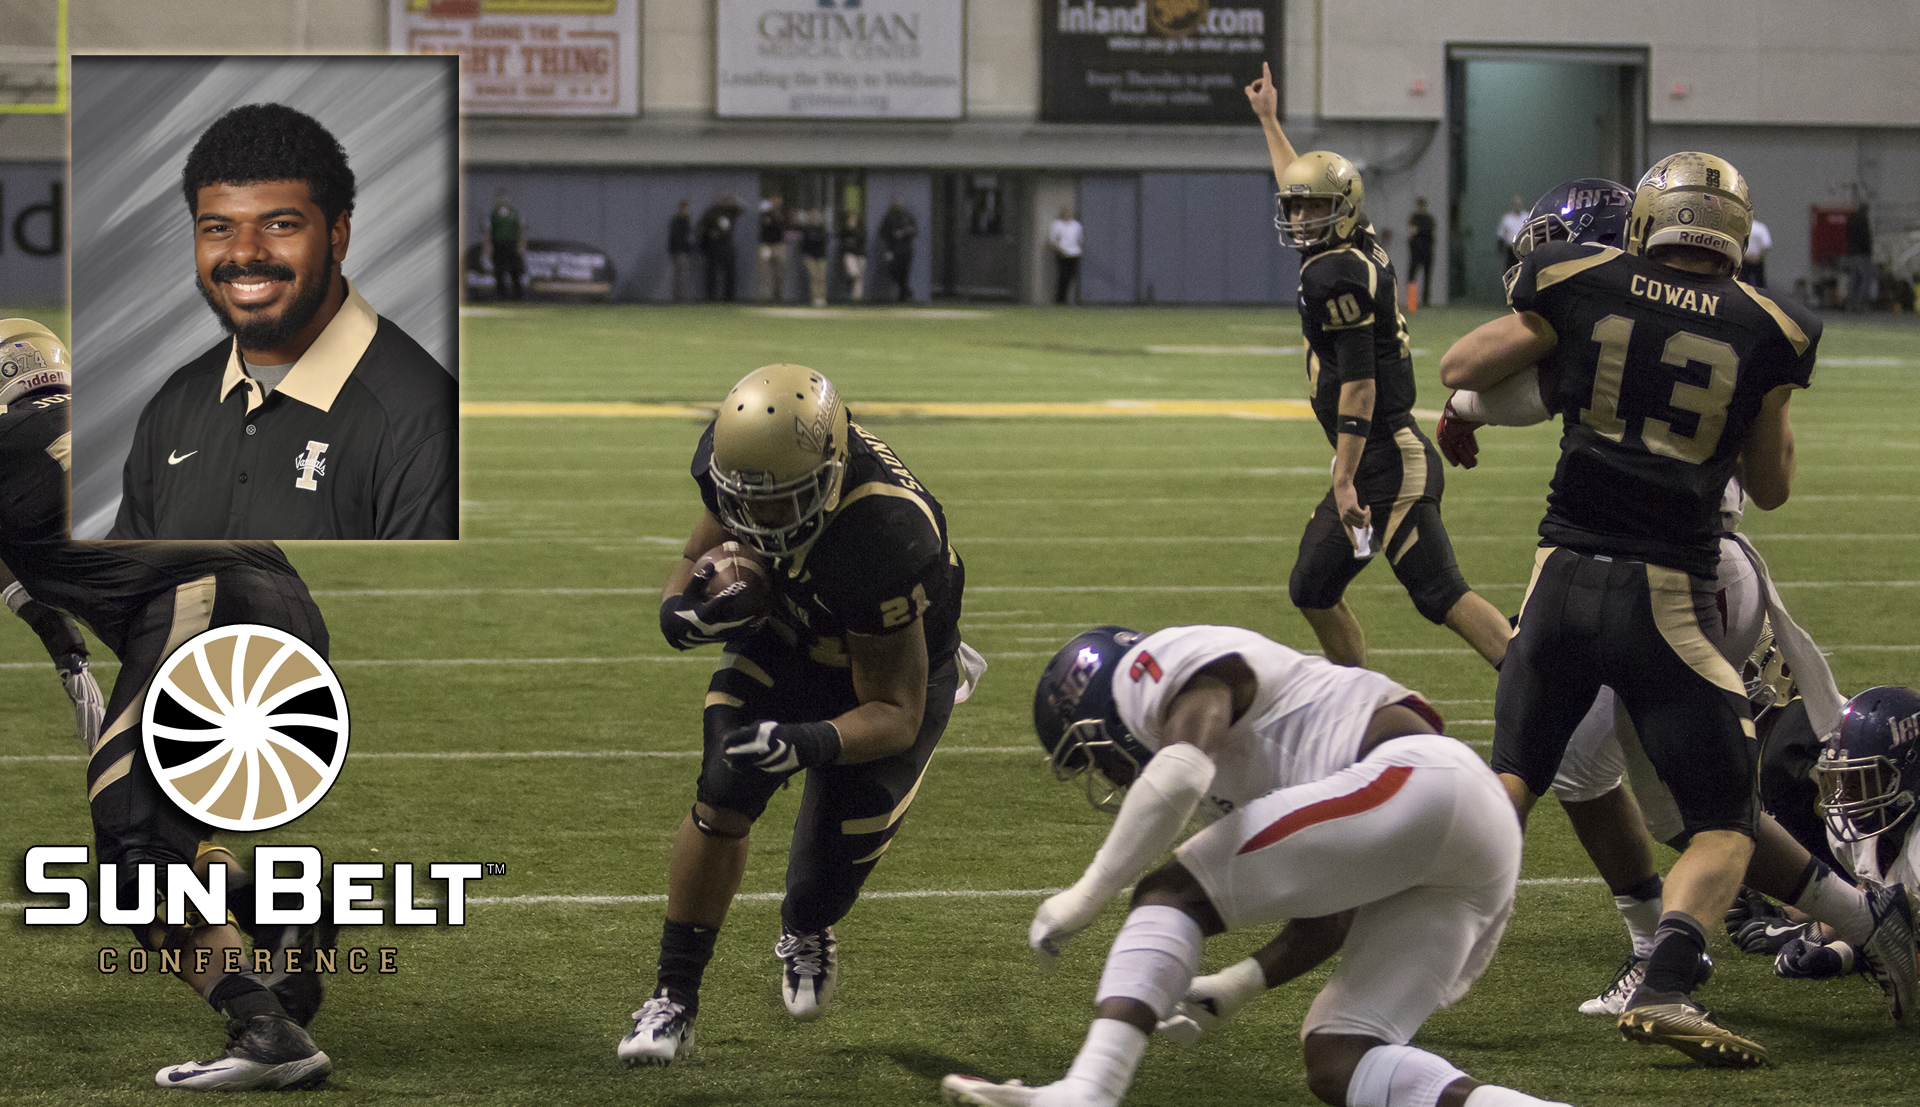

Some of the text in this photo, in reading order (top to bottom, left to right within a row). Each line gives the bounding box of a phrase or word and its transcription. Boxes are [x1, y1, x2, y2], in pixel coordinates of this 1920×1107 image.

[757, 10, 920, 40] GRITMAN
[1058, 0, 1147, 33] inland
[1199, 8, 1265, 34] .com
[520, 46, 609, 75] THING
[1680, 231, 1730, 250] Riddell
[1326, 293, 1361, 326] 10
[1631, 274, 1720, 316] COWAN
[15, 350, 47, 373] 74
[1579, 314, 1740, 465] 13
[880, 582, 931, 628] 21
[1129, 650, 1163, 683] 7
